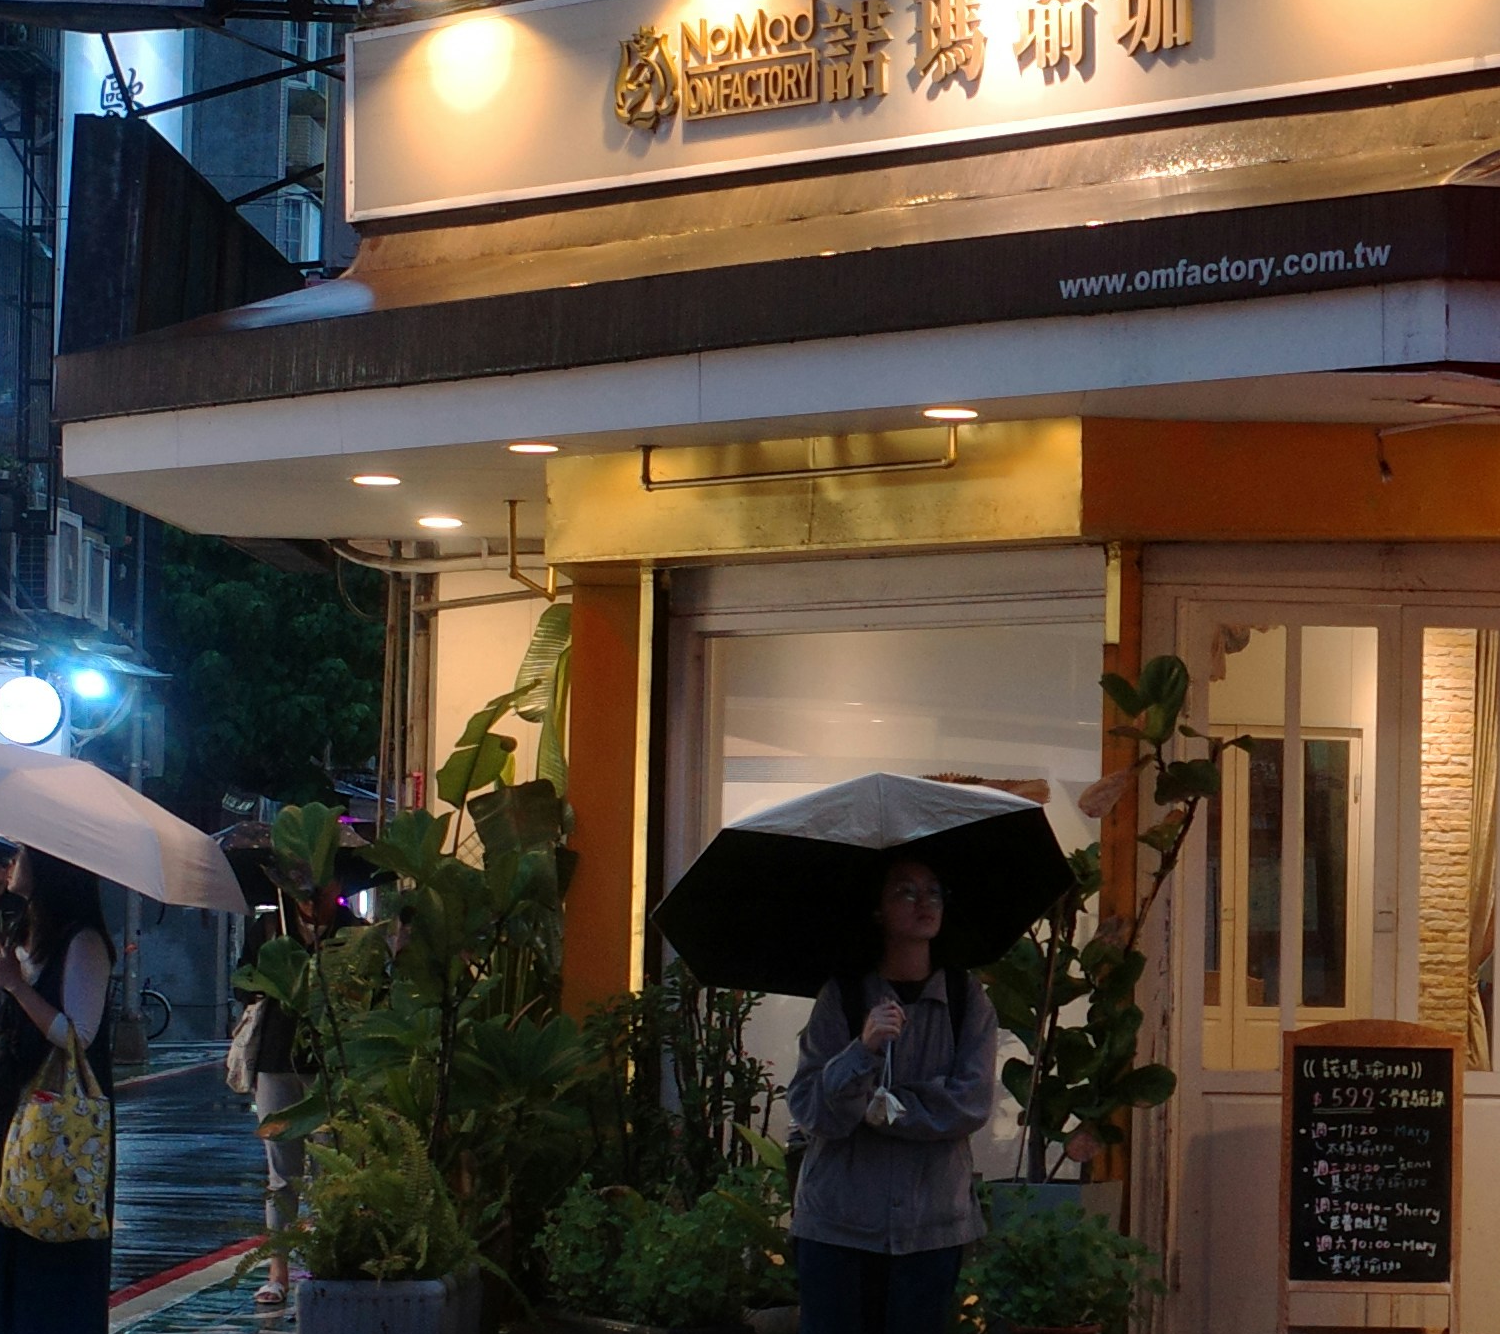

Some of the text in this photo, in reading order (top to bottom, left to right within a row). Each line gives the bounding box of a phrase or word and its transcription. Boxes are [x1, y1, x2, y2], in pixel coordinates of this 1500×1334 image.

[686, 58, 813, 117] OMFACTORY
[1058, 240, 1392, 300] www.omfactory.com.tw
[1331, 1087, 1375, 1108] 599
